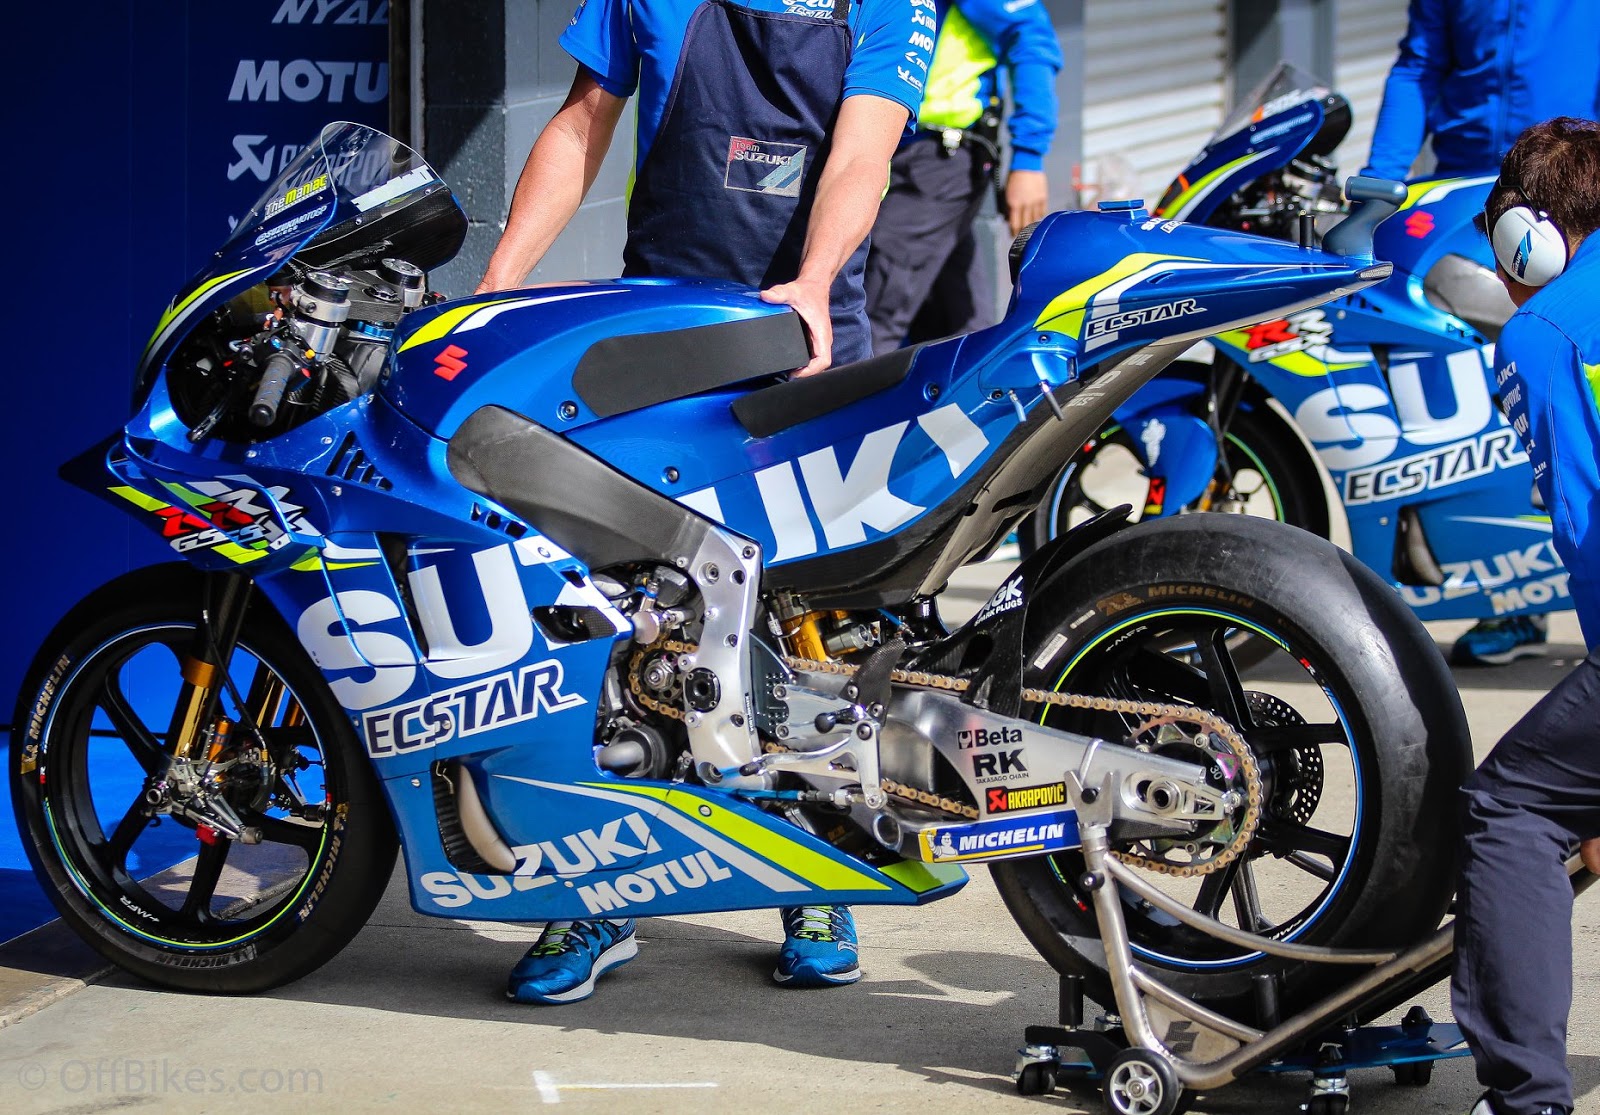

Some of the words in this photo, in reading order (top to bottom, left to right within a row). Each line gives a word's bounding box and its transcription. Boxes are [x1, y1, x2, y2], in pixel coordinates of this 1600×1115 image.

[228, 59, 389, 102] MOTU
[734, 149, 791, 167] SUZUKI
[1084, 298, 1208, 341] ECSTAR
[1344, 427, 1531, 506] ECSTAR
[996, 598, 1023, 614] PLUGS
[1148, 585, 1254, 608] MICHELIN
[29, 654, 71, 740] MICHELIN
[362, 659, 588, 759] ECSTAR
[975, 726, 1023, 748] Beta
[973, 748, 1028, 777] RK
[1210, 764, 1222, 781] 30
[959, 823, 1065, 850] MICHELIN
[298, 835, 341, 922] MICHELIN
[421, 812, 661, 908] SUZUKI
[576, 850, 732, 915] MOTUL
